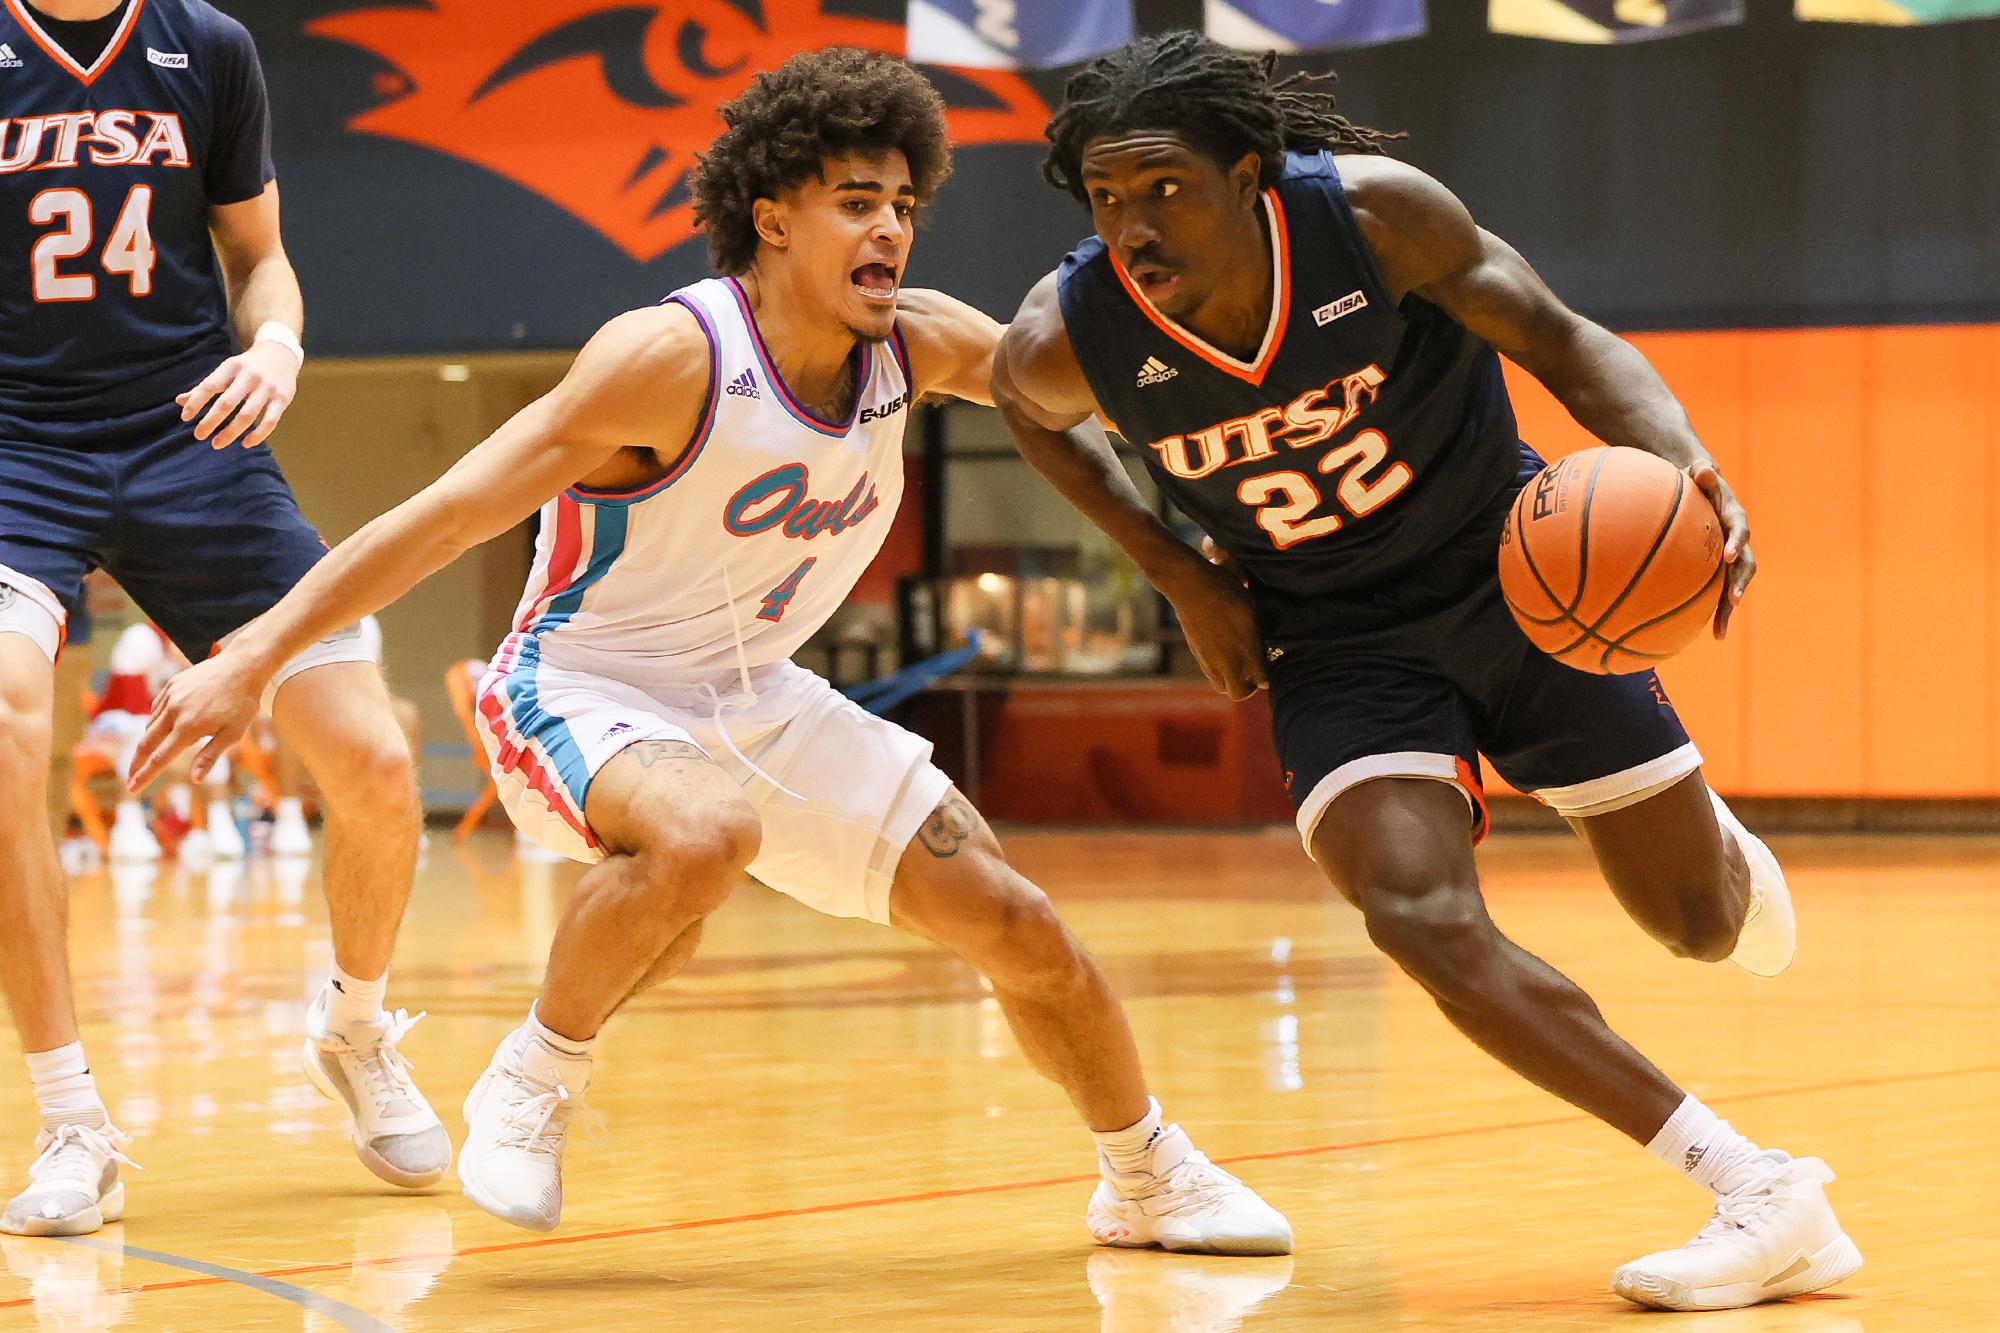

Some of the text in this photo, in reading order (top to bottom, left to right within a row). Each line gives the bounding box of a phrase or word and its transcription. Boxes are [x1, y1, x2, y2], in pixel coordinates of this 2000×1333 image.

[0, 108, 192, 175] UTSA
[28, 183, 157, 302] 24
[726, 383, 761, 401] adidas
[1136, 367, 1179, 388] adidas
[1148, 363, 1388, 480] UTSA
[723, 462, 879, 540] Owls
[1236, 427, 1413, 550] 22
[755, 556, 817, 623] 4
